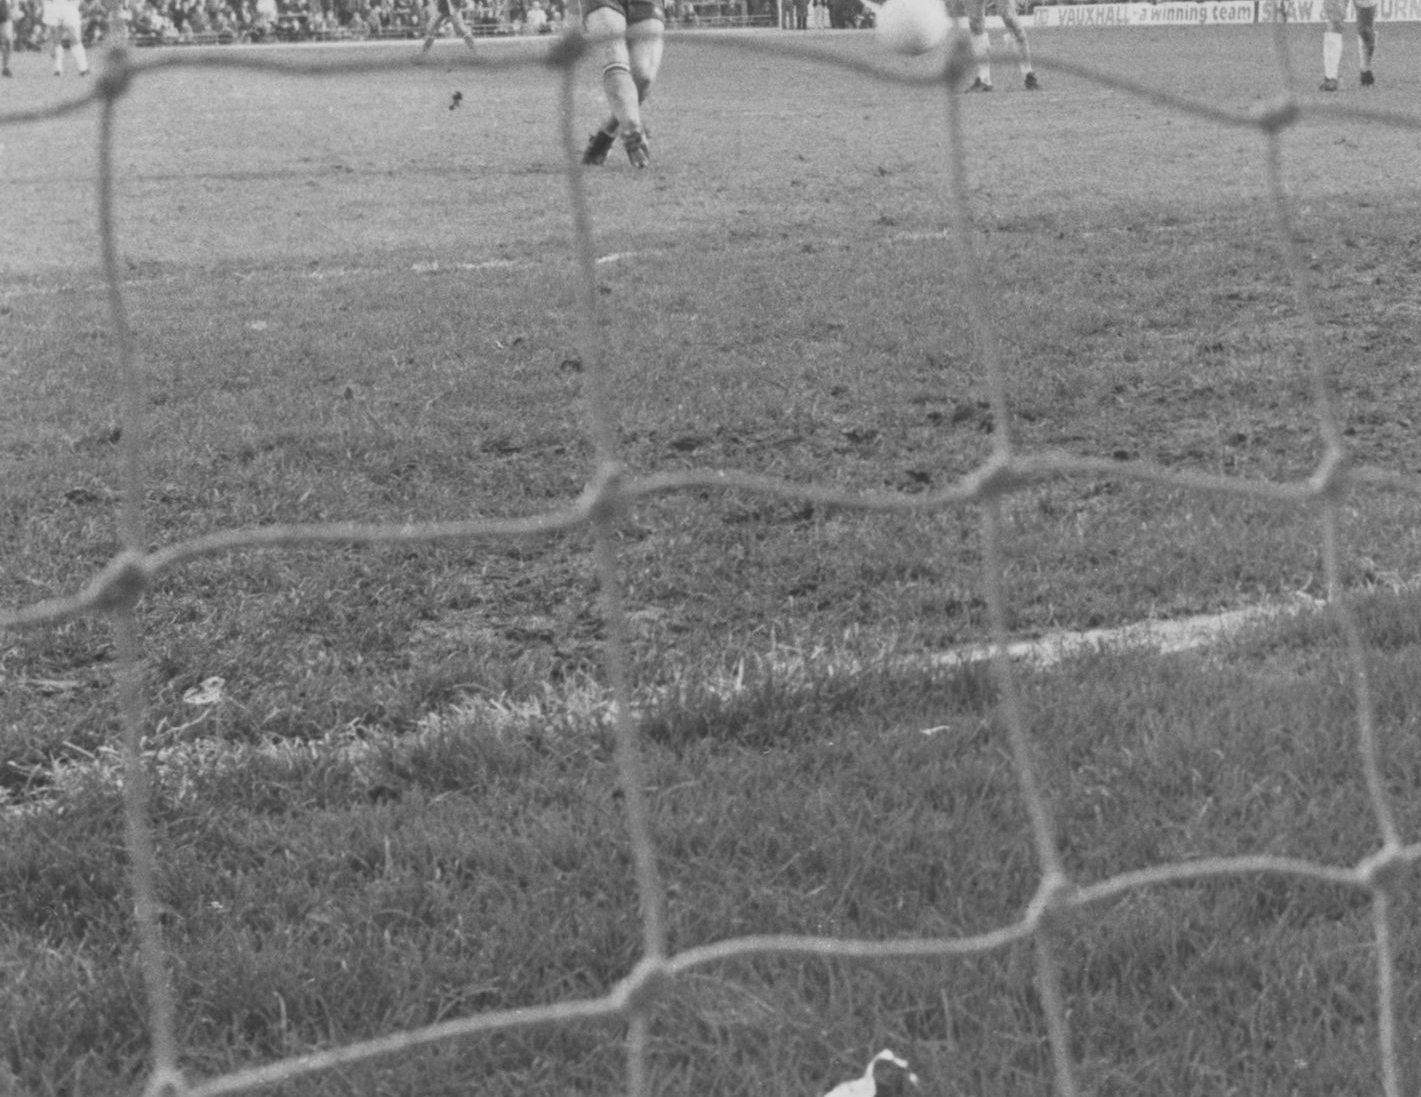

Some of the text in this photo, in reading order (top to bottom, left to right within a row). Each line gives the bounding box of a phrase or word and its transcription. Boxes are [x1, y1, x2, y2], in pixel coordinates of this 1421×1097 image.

[1058, 5, 1129, 25] VAUXHALL
[1151, 4, 1207, 24] winning
[1212, 5, 1251, 20] team
